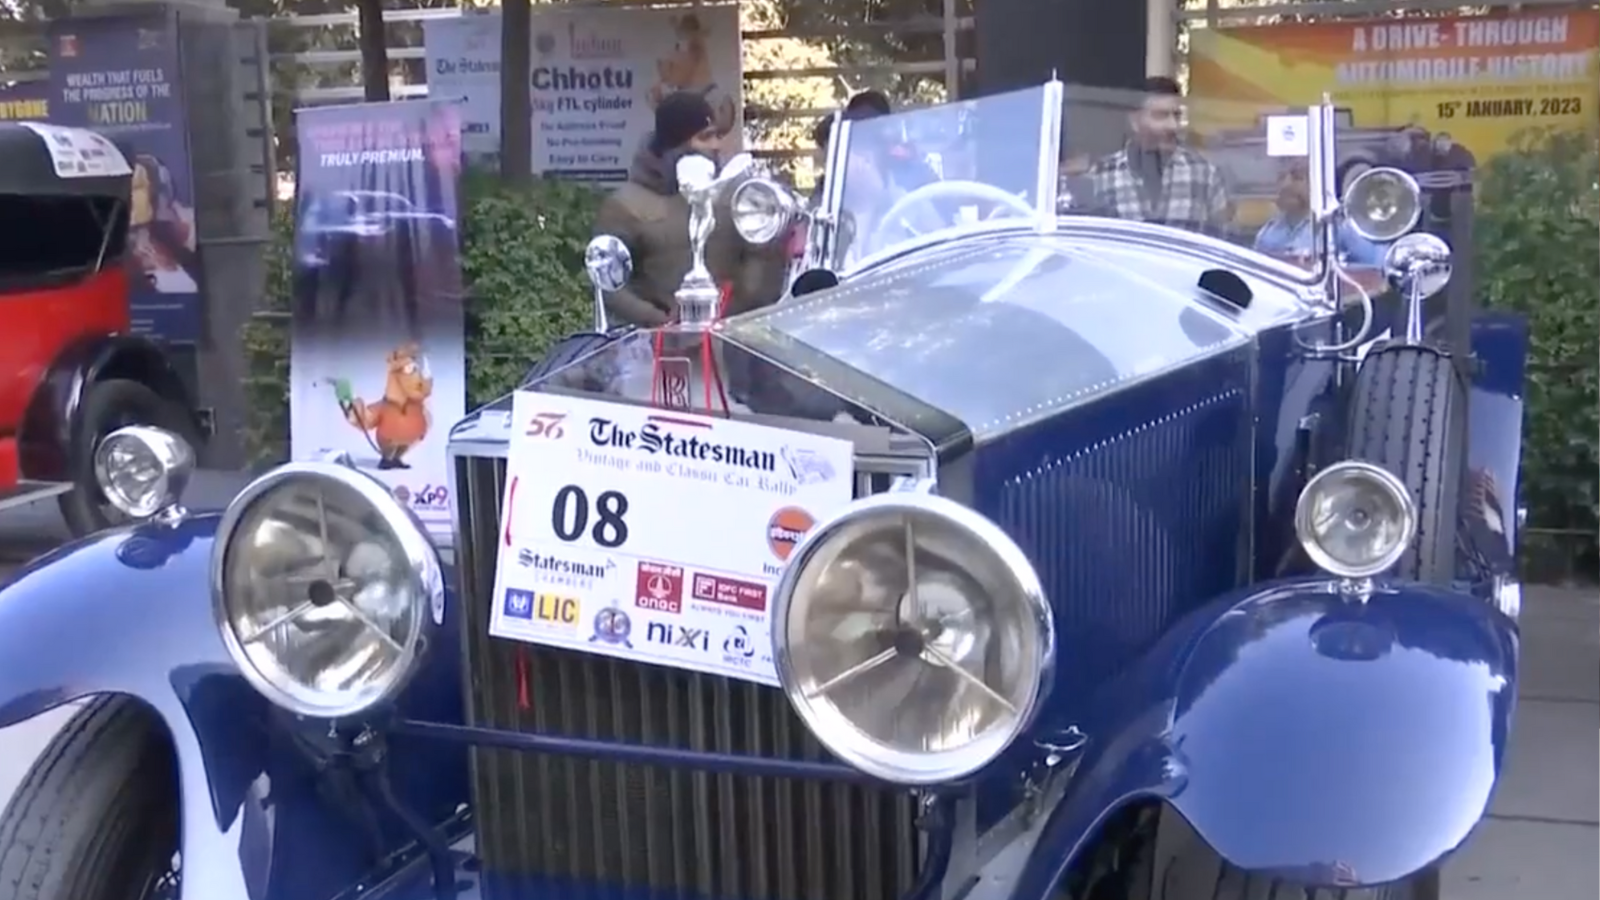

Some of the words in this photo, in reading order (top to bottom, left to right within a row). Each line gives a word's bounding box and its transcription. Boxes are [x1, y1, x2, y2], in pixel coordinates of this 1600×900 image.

[1353, 26, 1367, 51] A
[1454, 16, 1569, 47] THROUGH
[67, 72, 102, 87] WEALTH
[106, 70, 130, 85] THAT
[133, 68, 164, 83] FUELS
[532, 66, 633, 90] Chhotu
[63, 88, 81, 102] THE
[83, 85, 134, 101] PROGRESS
[136, 84, 149, 98] OF
[151, 83, 171, 97] THE
[88, 101, 148, 124] NATION
[557, 96, 581, 111] FTL
[583, 95, 632, 113] cylinder
[1540, 96, 1582, 116] 2023
[320, 153, 359, 168] TRULY
[549, 154, 575, 165] Easy
[578, 154, 589, 163] to
[591, 154, 619, 166] Carry
[589, 417, 637, 449] The
[637, 423, 776, 472] Statesman
[577, 448, 631, 471] Vintage
[636, 458, 661, 473] and
[664, 461, 718, 482] Classic
[723, 472, 750, 488] Car
[757, 476, 798, 496] Rally
[414, 484, 451, 505] XP9
[551, 484, 629, 548] 08
[518, 547, 604, 578] Statesman
[717, 583, 738, 594] IDFC
[739, 587, 764, 600] FIRST
[538, 594, 576, 624] LIC
